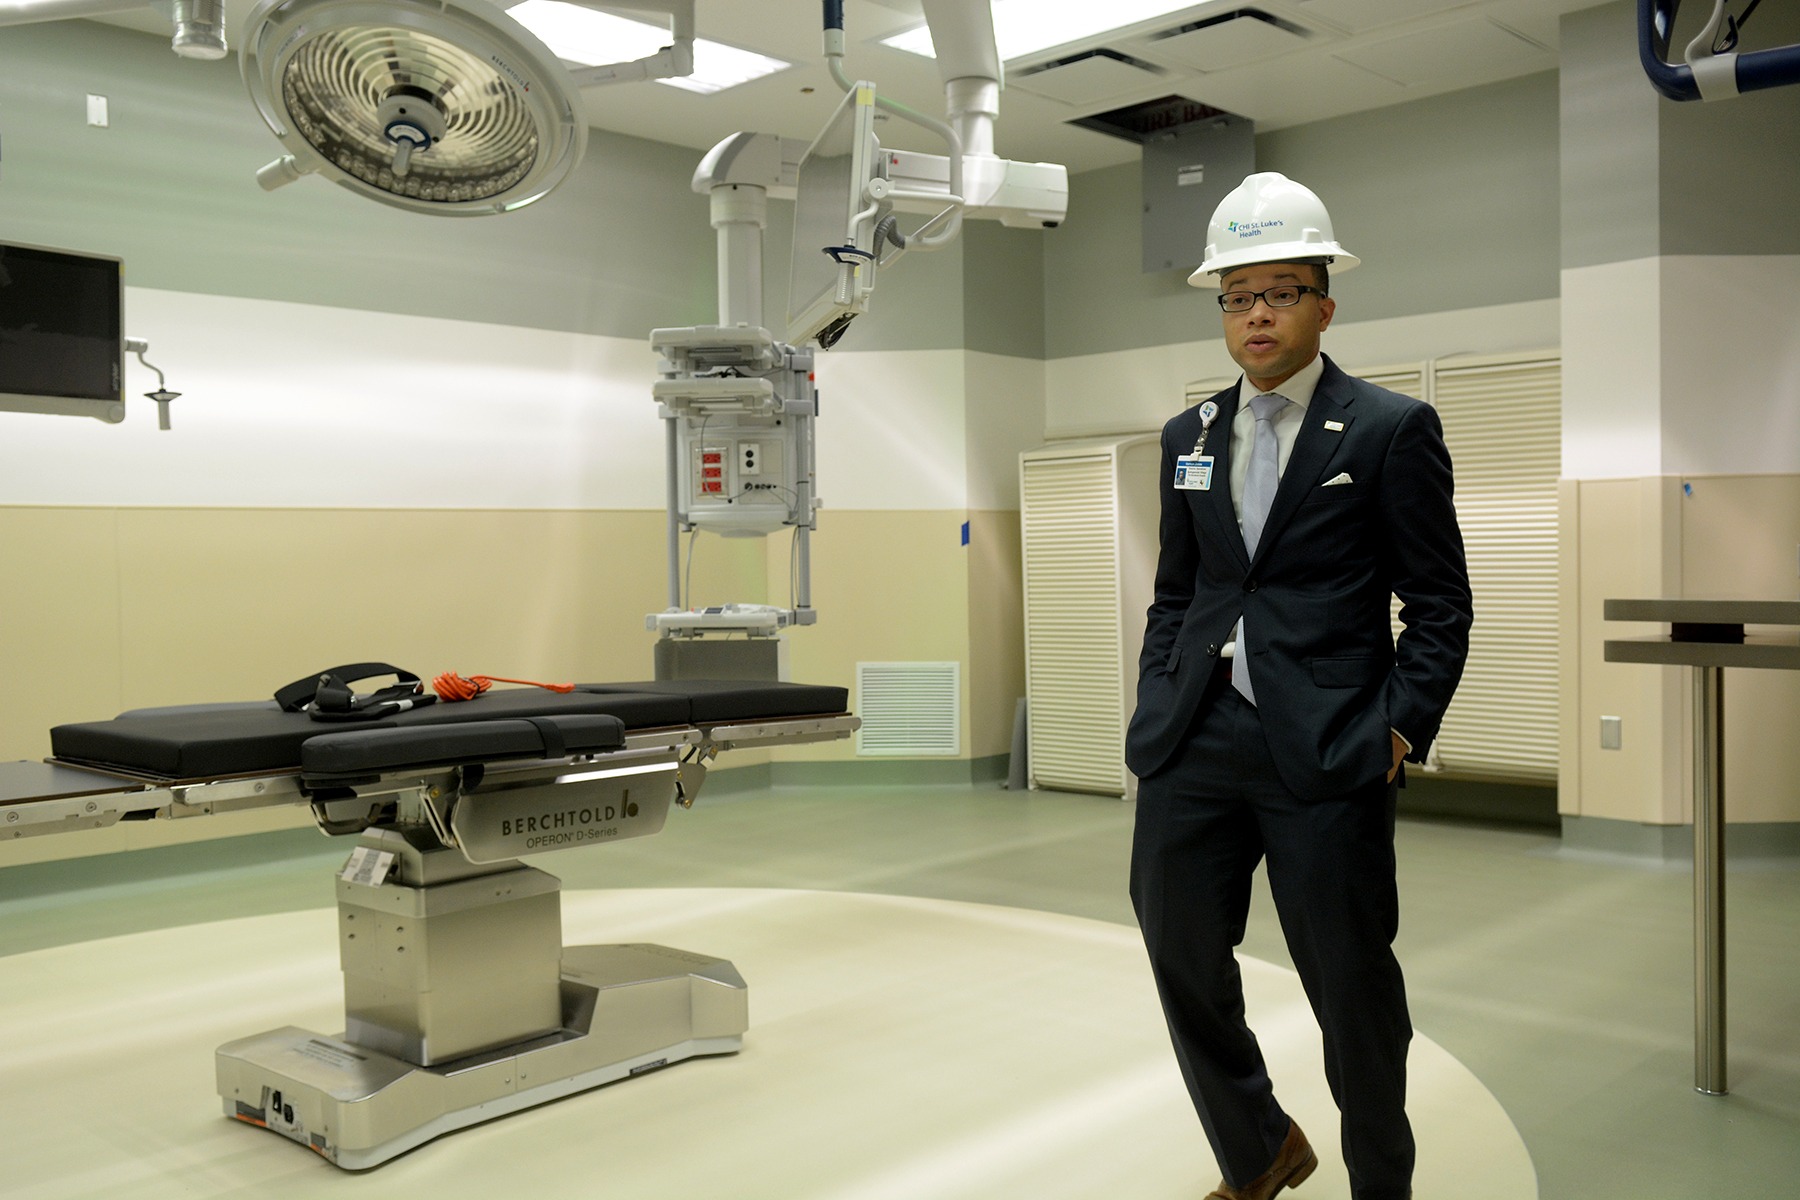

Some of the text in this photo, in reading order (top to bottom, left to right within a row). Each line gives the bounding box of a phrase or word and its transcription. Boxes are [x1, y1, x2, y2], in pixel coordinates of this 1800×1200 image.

[1260, 220, 1284, 228] Luke's
[1239, 229, 1262, 238] Health
[502, 805, 616, 836] BERCHTOLD
[576, 827, 618, 841] D-Series
